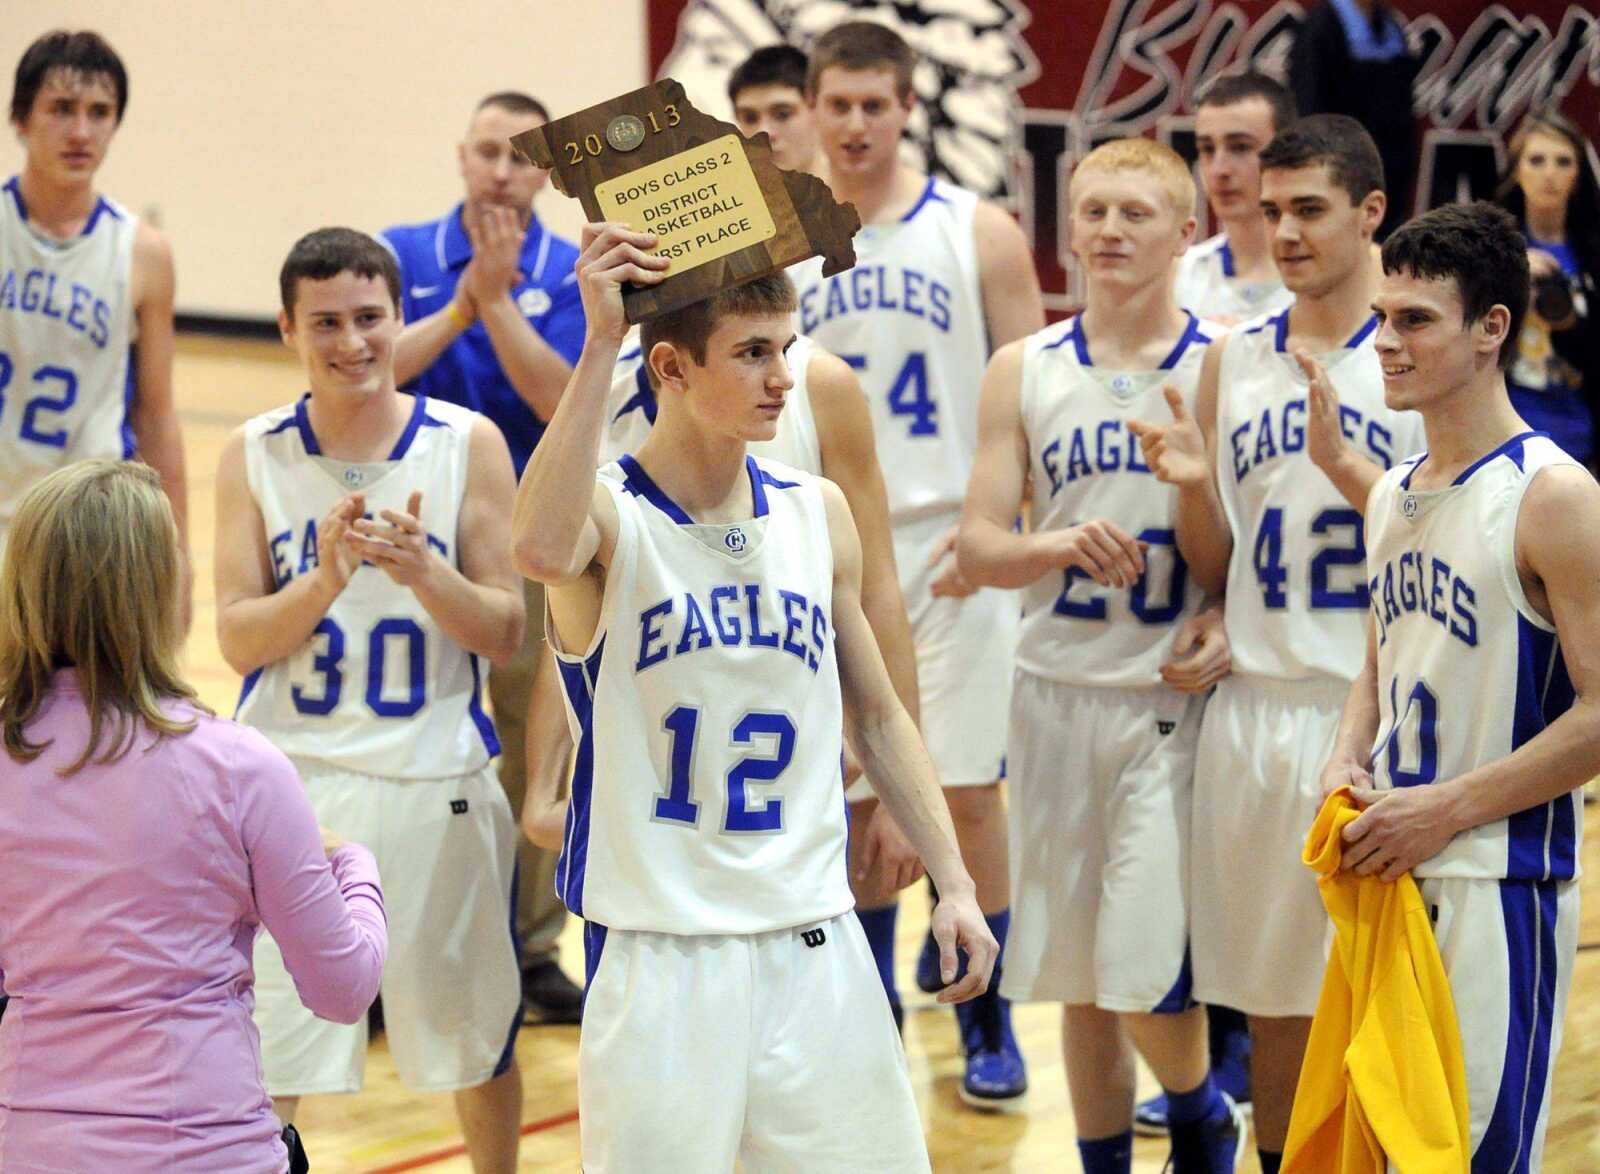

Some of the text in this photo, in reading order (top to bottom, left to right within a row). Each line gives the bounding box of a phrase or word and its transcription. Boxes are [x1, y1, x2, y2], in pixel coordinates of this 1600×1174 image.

[615, 152, 732, 205] BOYS CLASS 2
[642, 183, 718, 221] DISTRICT
[647, 196, 743, 236] SKETBALL
[654, 218, 752, 259] RST PLACE
[0, 269, 110, 350] AGLES
[800, 266, 952, 335] EAGLES
[0, 352, 78, 449] 2
[841, 352, 938, 437] 4
[1043, 421, 1153, 498] EAGL
[1231, 400, 1393, 484] EAGES
[1254, 508, 1371, 609] 42
[292, 618, 426, 718] 30
[635, 584, 829, 674] EAGLES
[650, 704, 798, 835] 12
